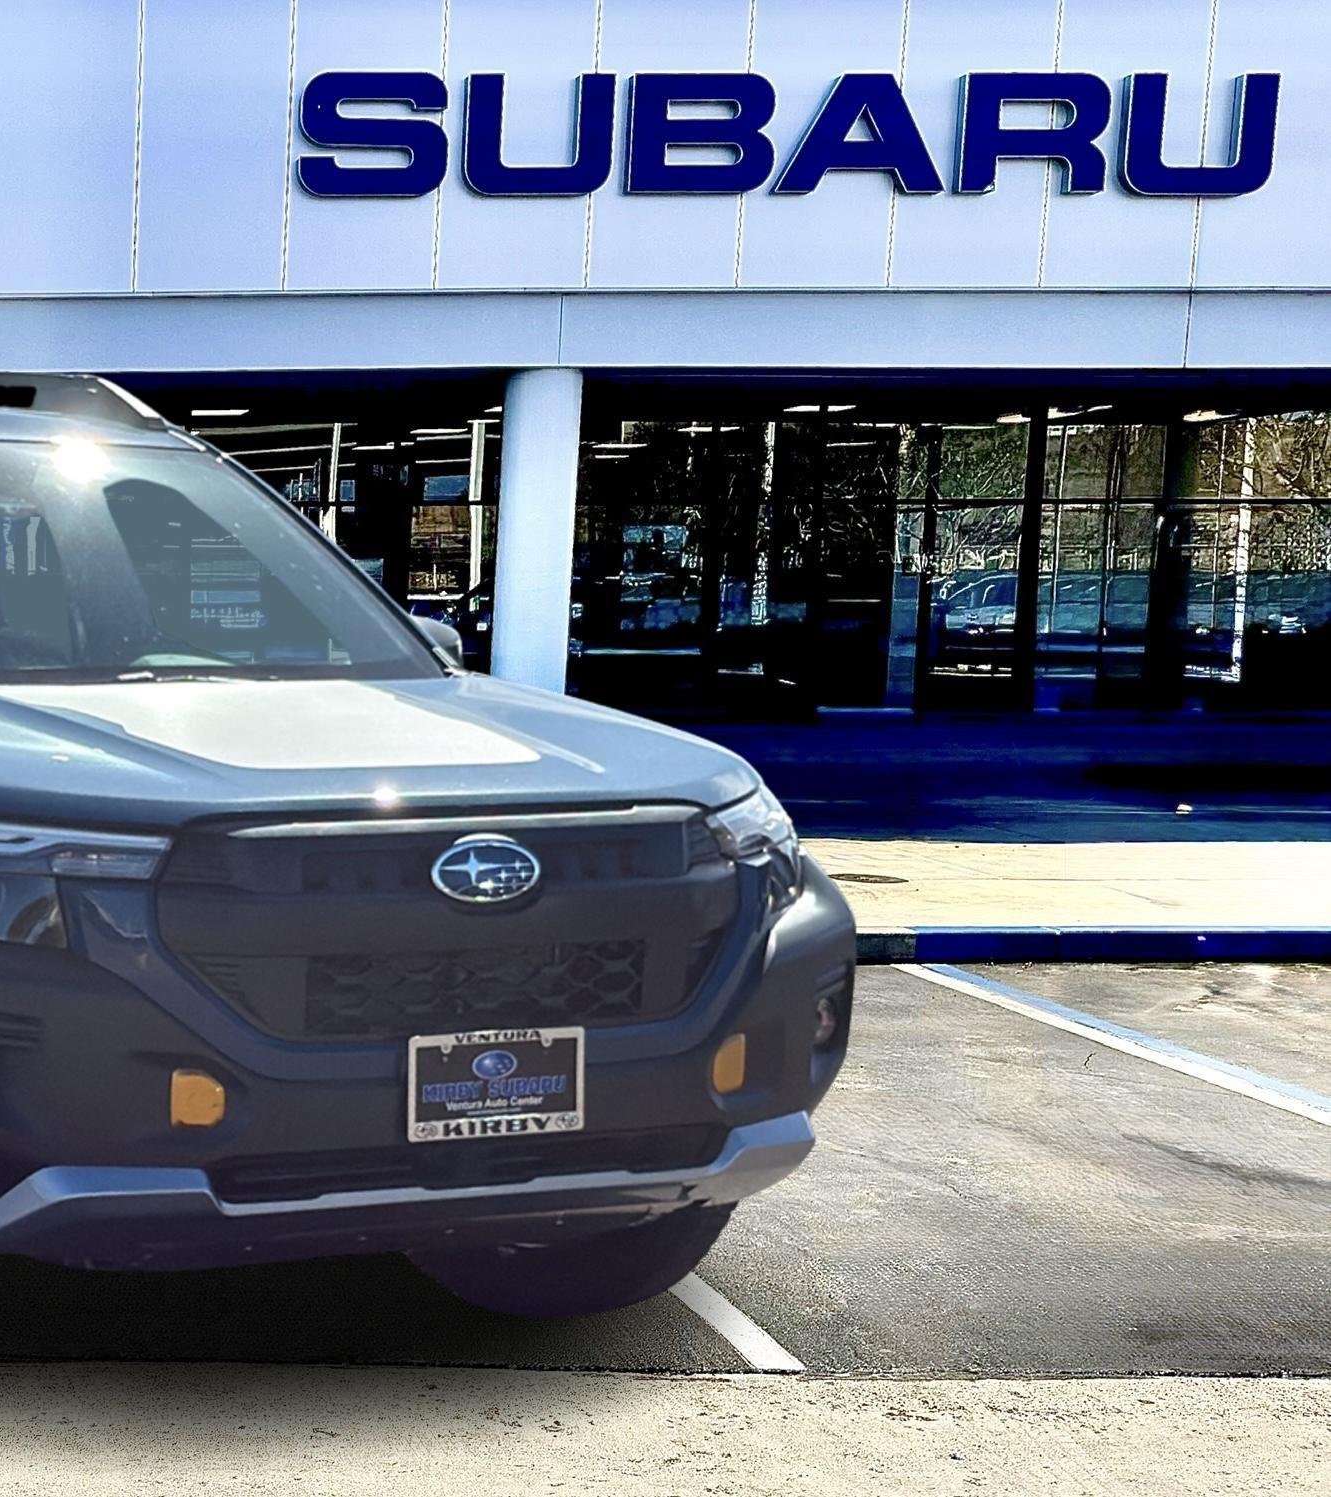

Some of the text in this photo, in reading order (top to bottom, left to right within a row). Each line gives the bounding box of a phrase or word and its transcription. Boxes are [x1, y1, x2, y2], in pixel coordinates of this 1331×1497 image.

[297, 70, 1281, 197] SUBARU
[455, 1030, 541, 1044] VENTURA
[422, 1074, 566, 1103] KIRBY SUBARU
[445, 1100, 483, 1111] Ventura
[484, 1097, 508, 1108] Auto
[510, 1095, 543, 1106] Center
[443, 1116, 552, 1137] KIRBY
